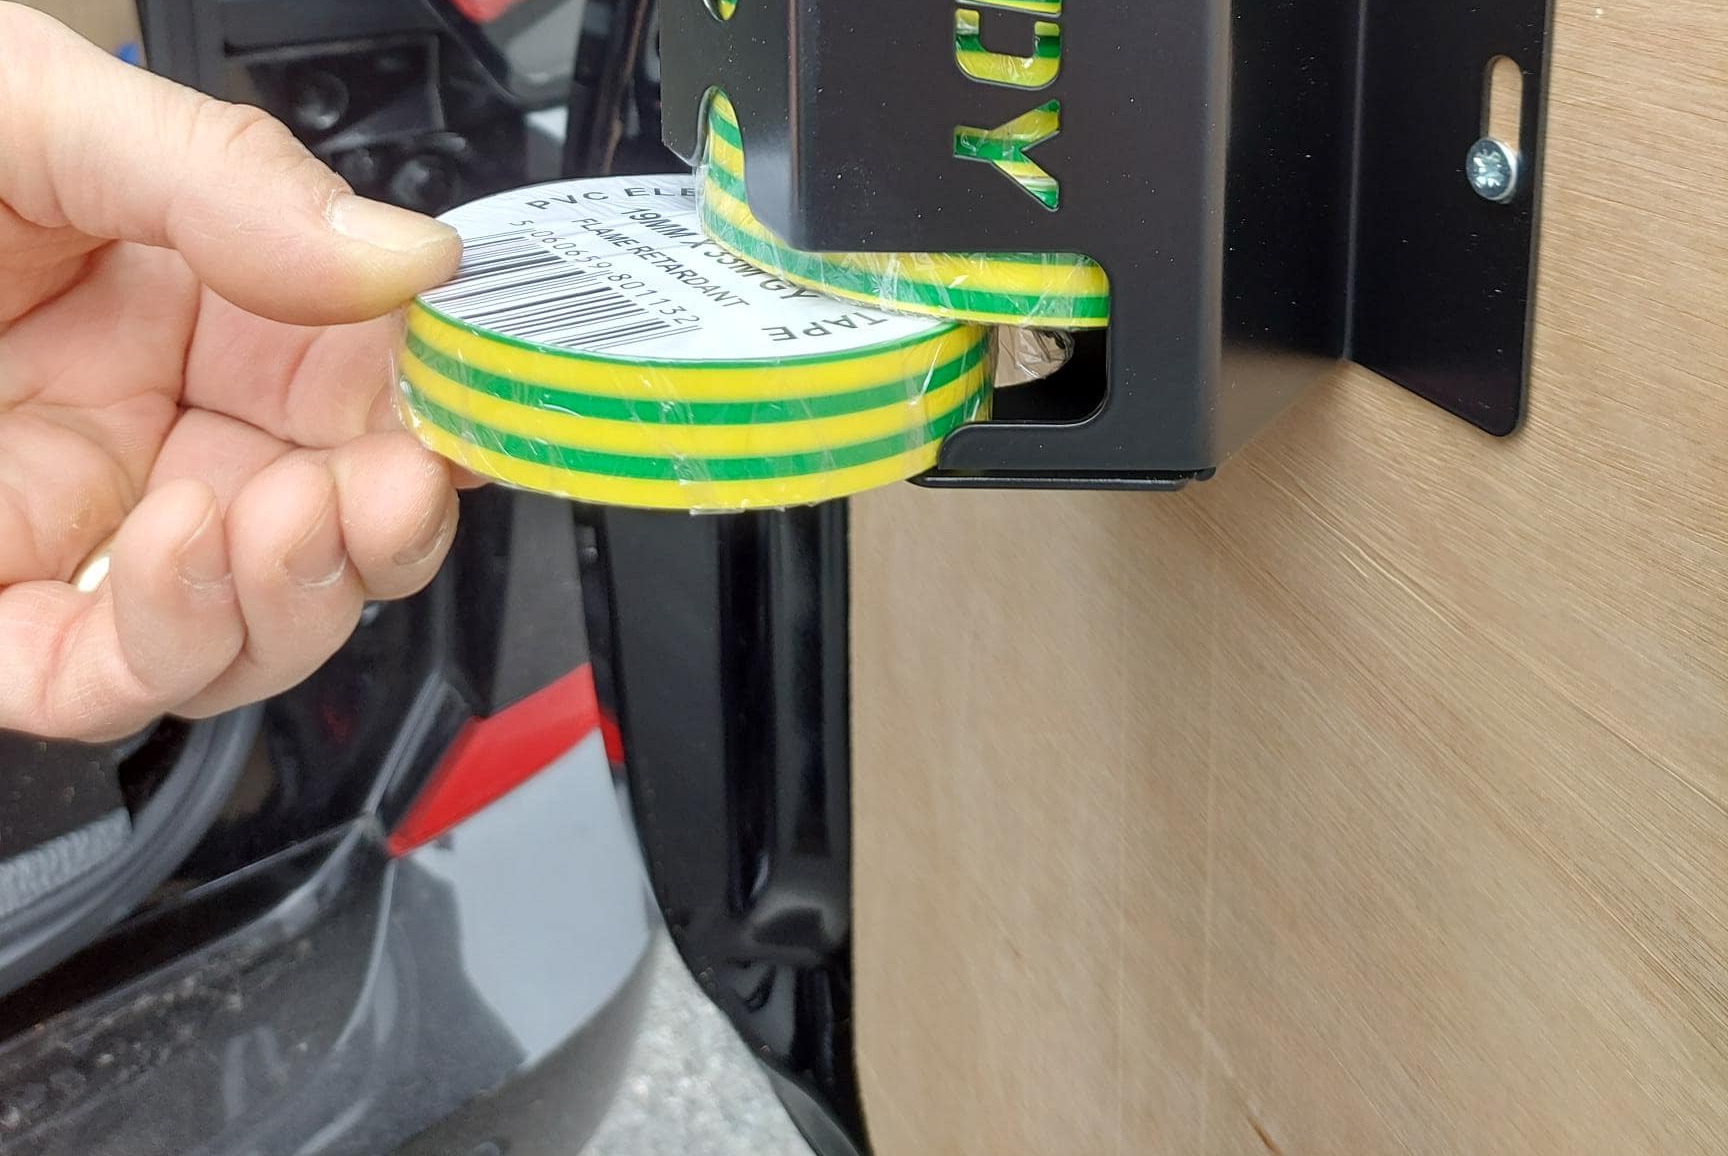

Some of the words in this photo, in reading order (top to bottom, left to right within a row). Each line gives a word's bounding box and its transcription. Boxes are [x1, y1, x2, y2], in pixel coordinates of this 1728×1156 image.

[524, 191, 610, 210] PVC
[621, 207, 700, 239] 19MM
[680, 237, 718, 249] X
[627, 245, 751, 307] RETARDANT
[761, 311, 889, 342] TAPE
